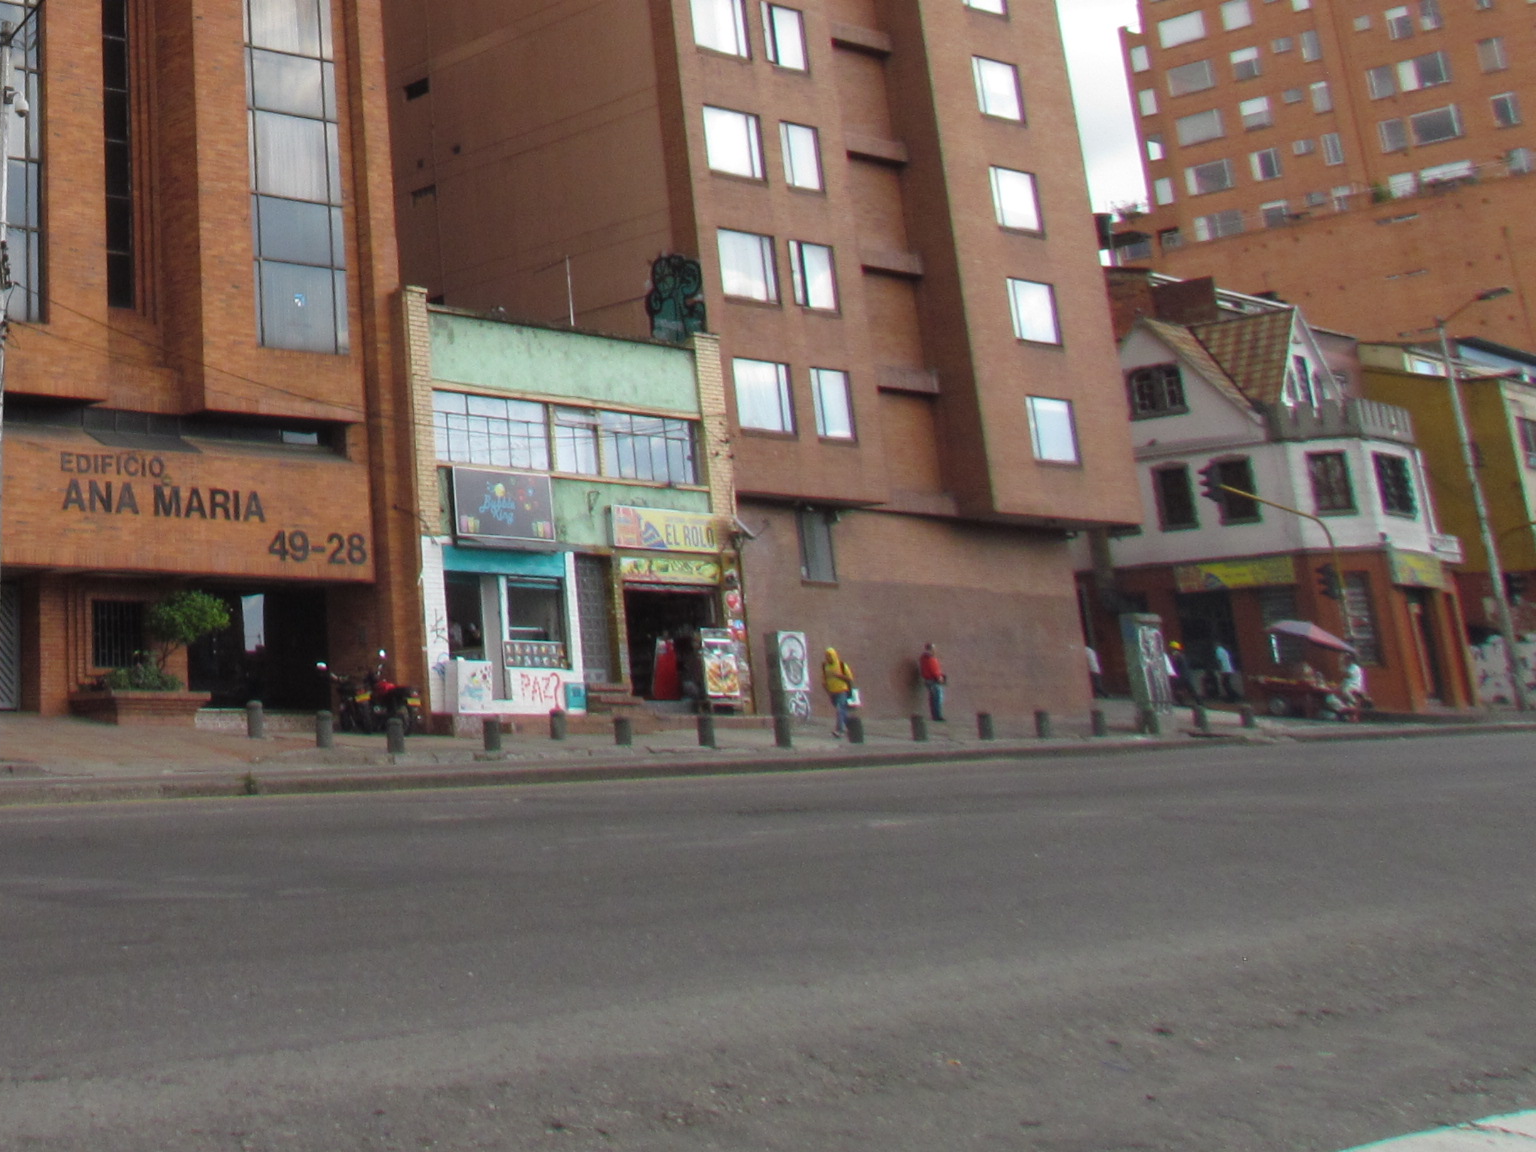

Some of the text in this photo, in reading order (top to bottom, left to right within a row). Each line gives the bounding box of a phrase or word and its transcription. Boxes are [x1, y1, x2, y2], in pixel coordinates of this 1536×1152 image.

[60, 451, 166, 478] EDIFICIO
[62, 477, 267, 524] ANA MARIA
[268, 529, 369, 566] 49-28
[665, 523, 681, 546] EL
